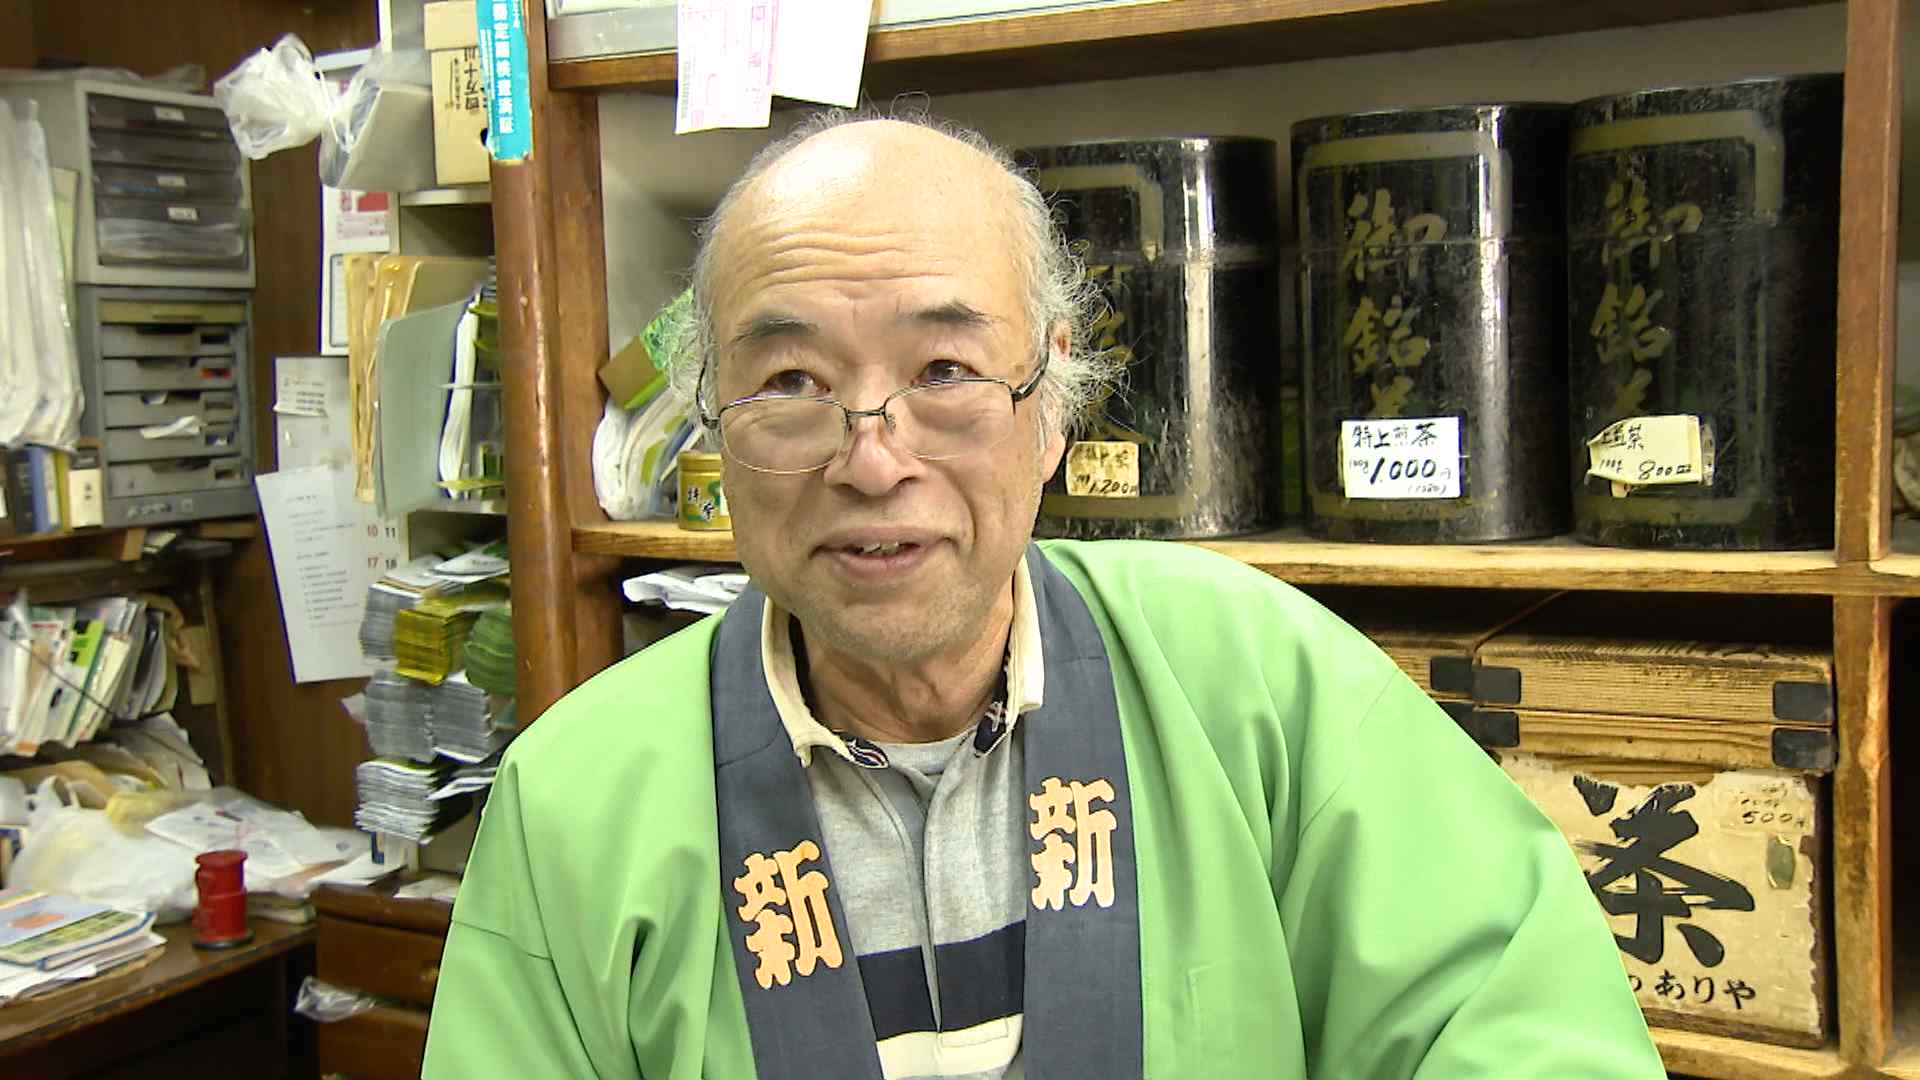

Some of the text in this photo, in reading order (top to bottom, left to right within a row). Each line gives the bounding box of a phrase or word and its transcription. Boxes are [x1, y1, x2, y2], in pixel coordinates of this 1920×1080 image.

[385, 526, 396, 538] 11
[1029, 776, 1118, 911] 新
[733, 839, 844, 990] 新
